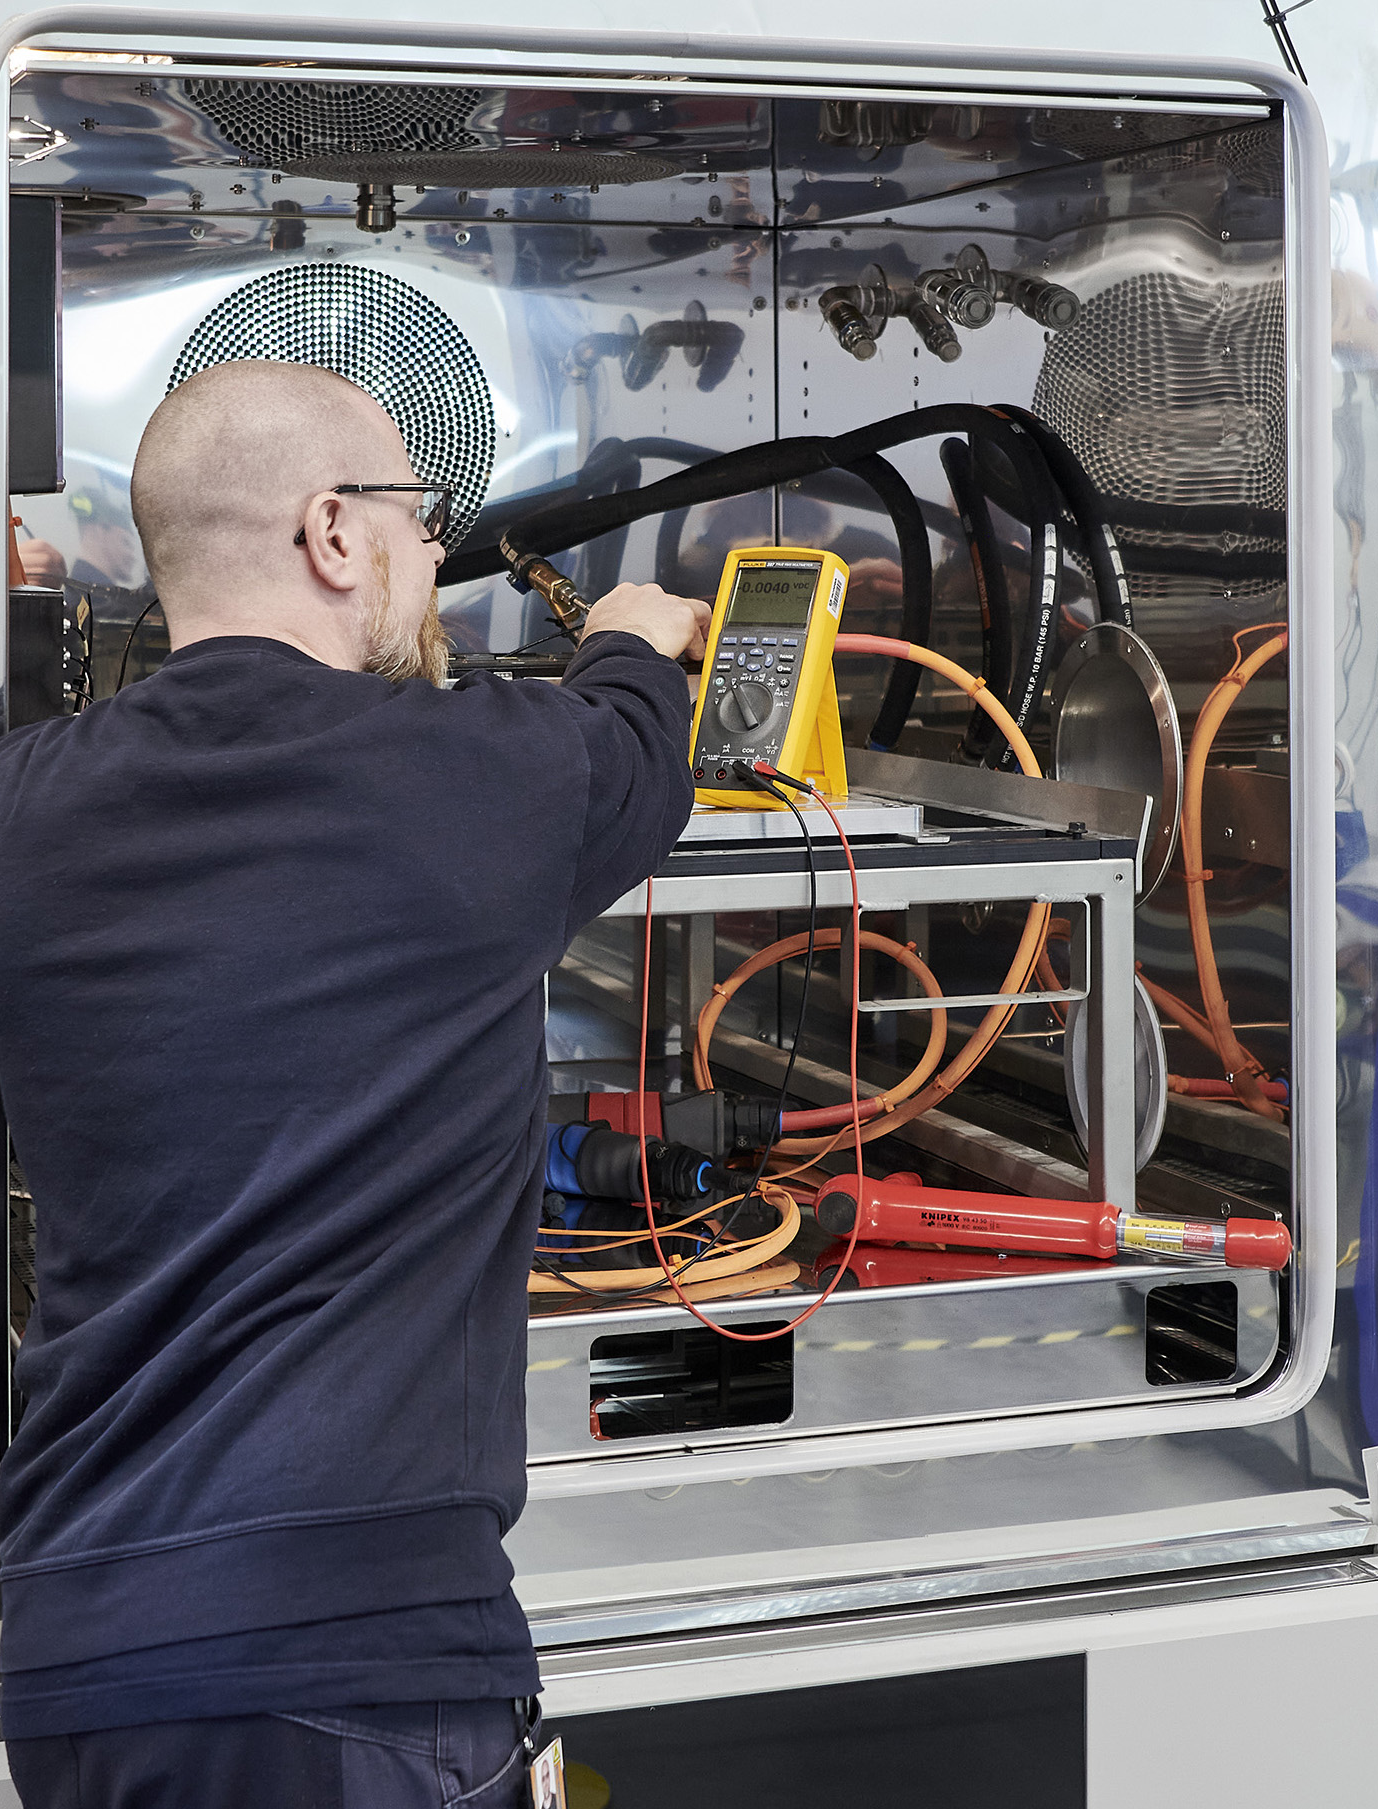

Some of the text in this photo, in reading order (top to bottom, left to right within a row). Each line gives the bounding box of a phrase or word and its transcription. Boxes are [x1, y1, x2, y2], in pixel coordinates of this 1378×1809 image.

[793, 582, 810, 590] VDC
[1041, 609, 1052, 626] PSI)
[1037, 627, 1048, 645] (145
[1034, 645, 1044, 664] BAR
[1032, 664, 1040, 673] 10
[1026, 675, 1038, 692] W.P.
[1020, 693, 1033, 715] HOSE
[1001, 751, 1011, 764] HOT
[921, 1212, 960, 1222] KNIPEX
